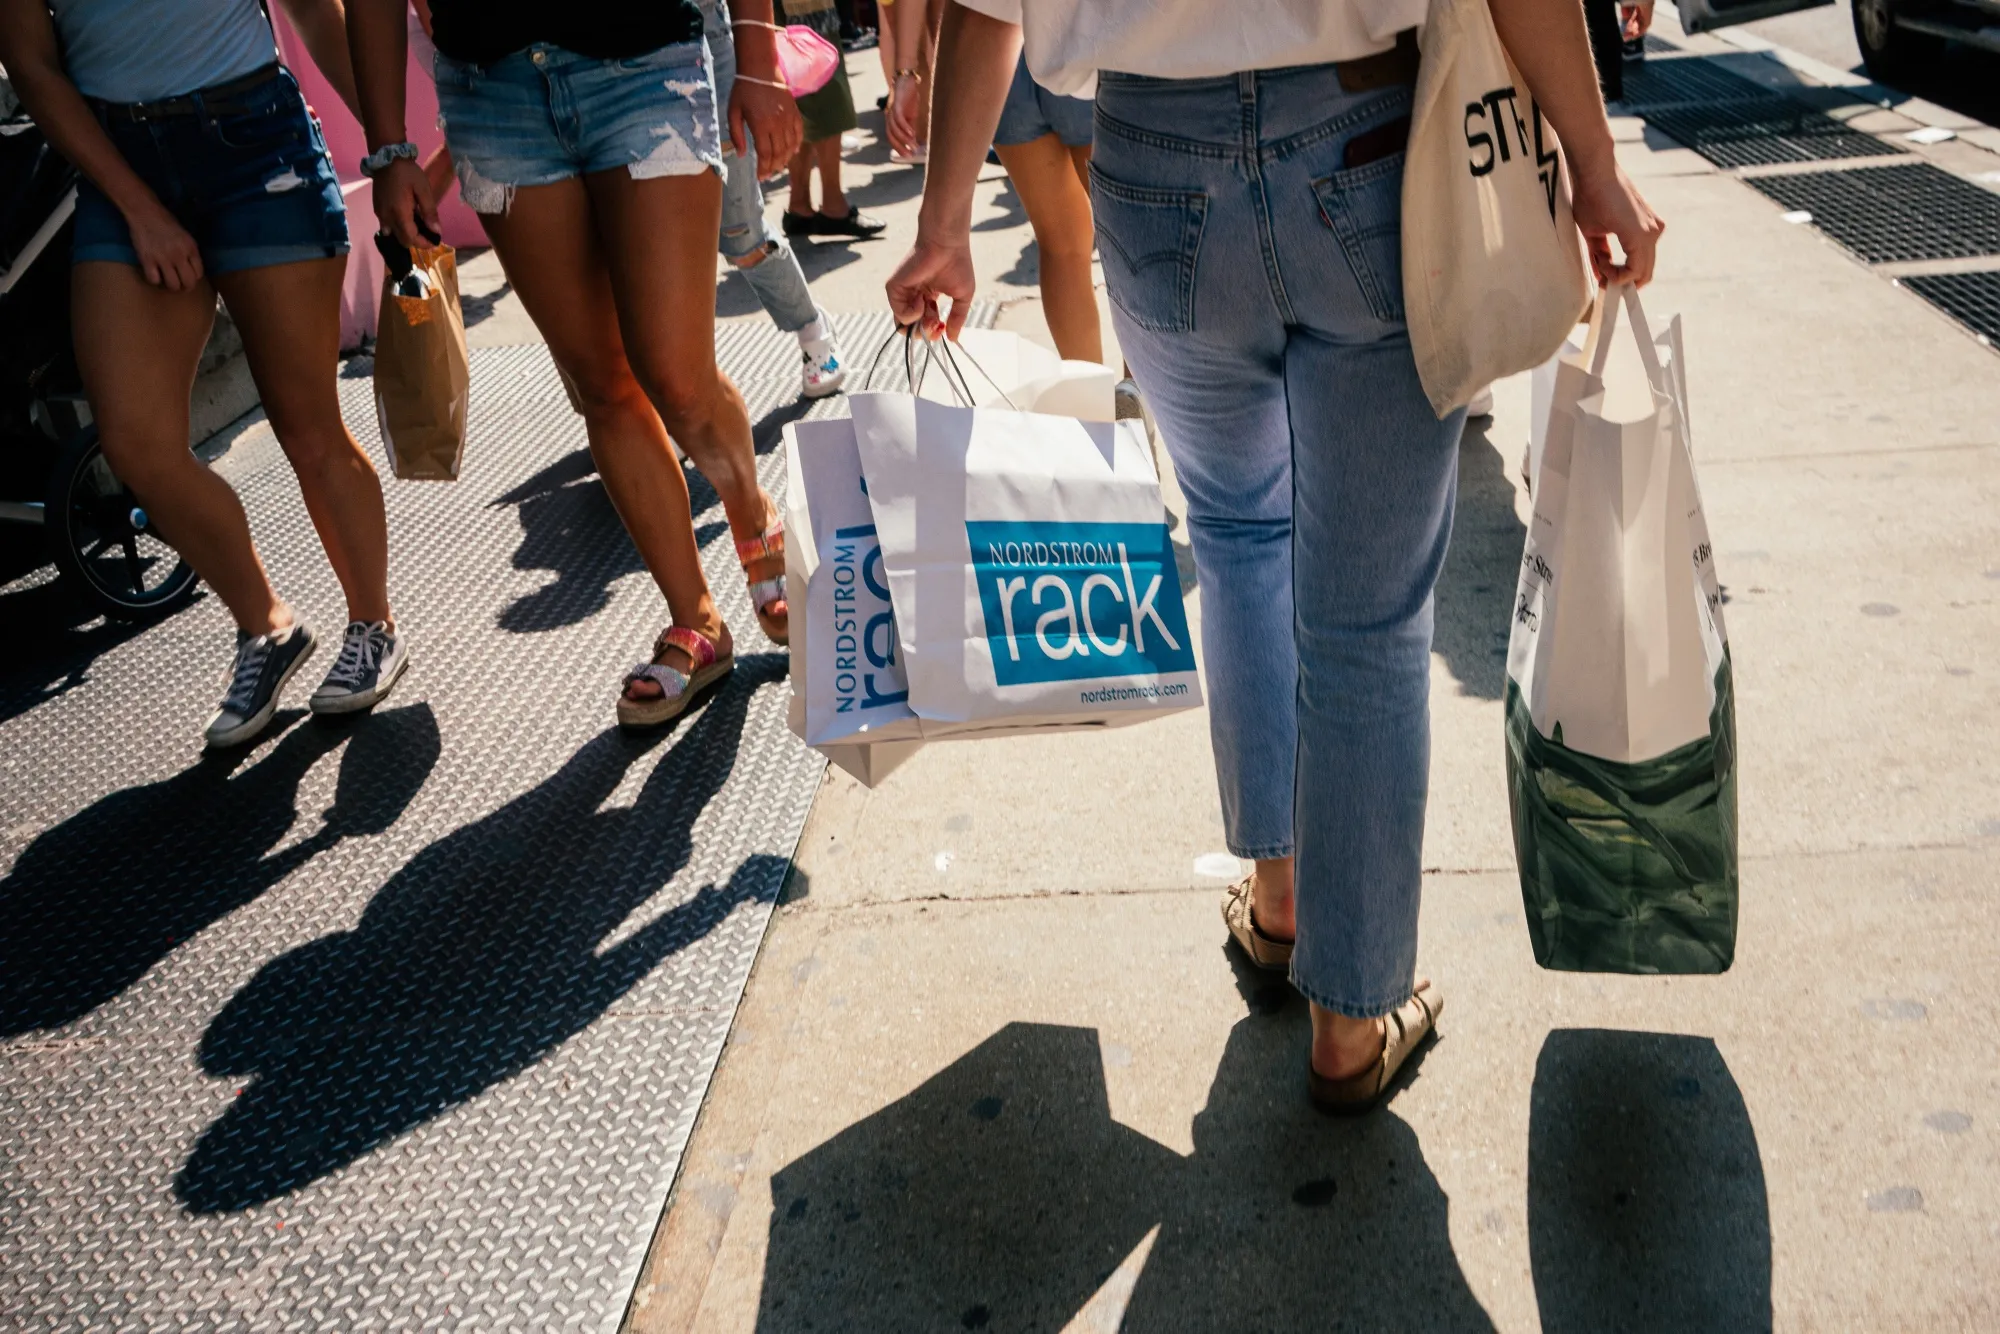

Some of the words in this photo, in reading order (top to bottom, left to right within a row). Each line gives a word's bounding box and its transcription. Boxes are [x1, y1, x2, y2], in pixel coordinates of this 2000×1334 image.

[989, 541, 1116, 567] NORDSTROM
[996, 542, 1181, 661] rack
[834, 544, 856, 712] NORDSTROM
